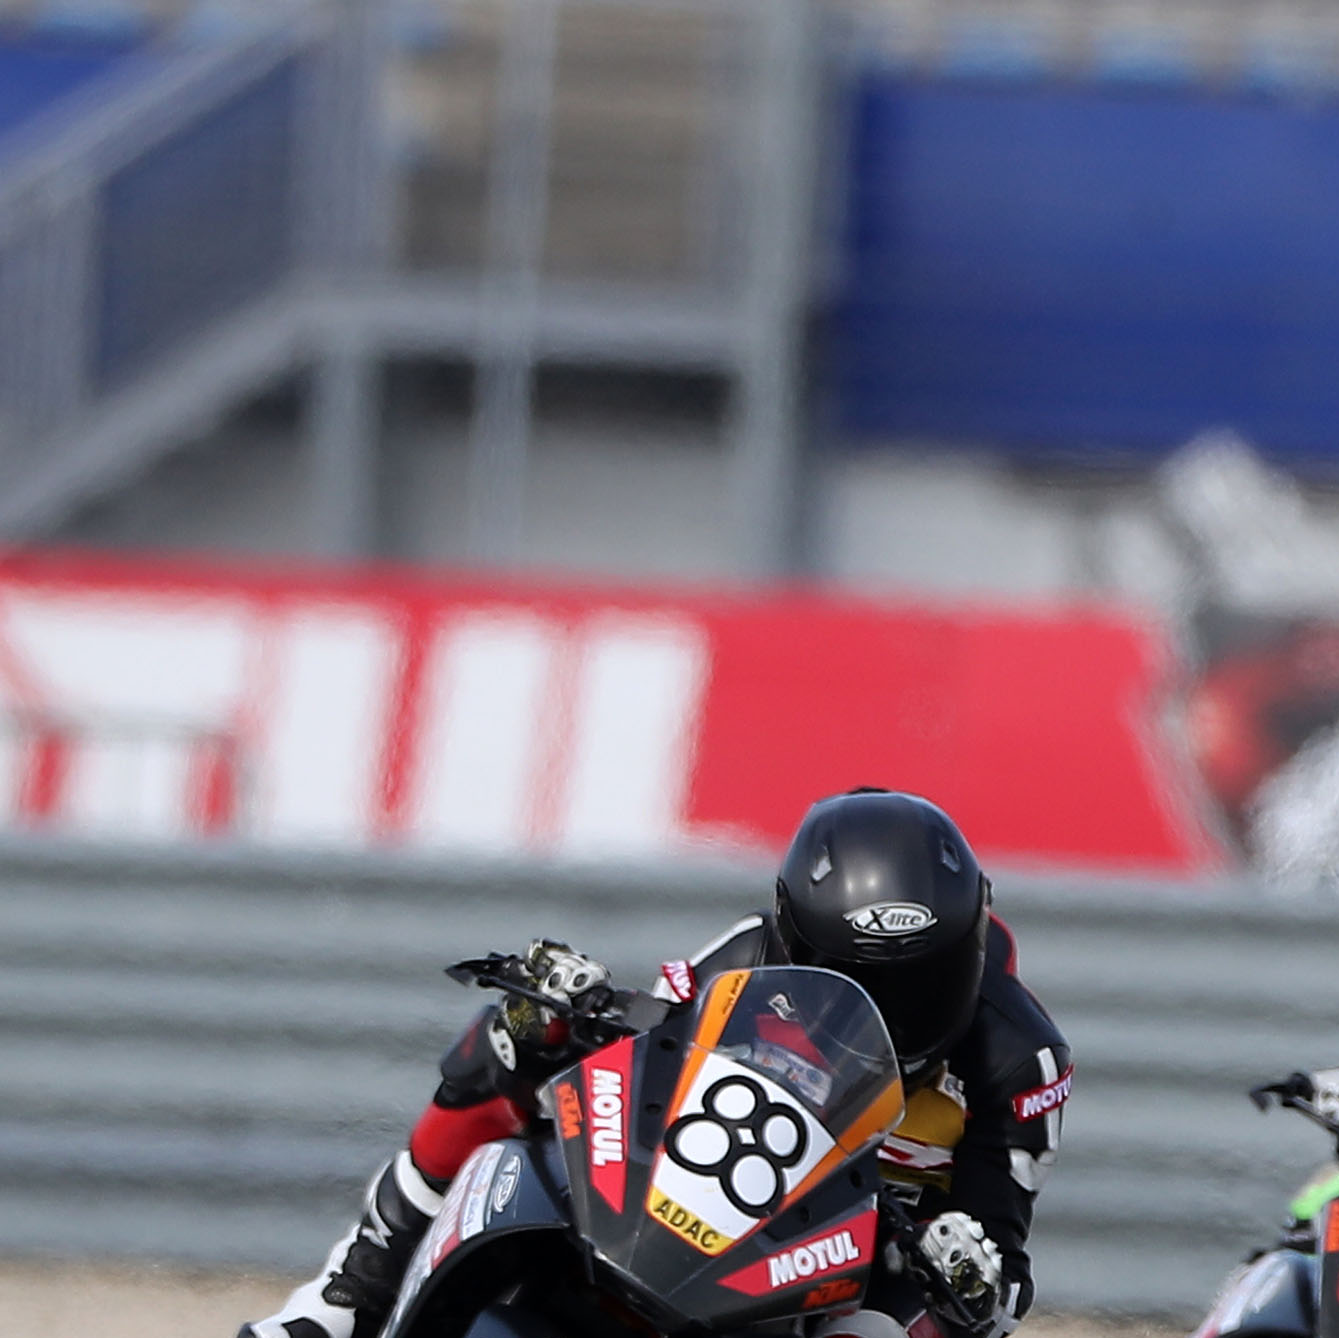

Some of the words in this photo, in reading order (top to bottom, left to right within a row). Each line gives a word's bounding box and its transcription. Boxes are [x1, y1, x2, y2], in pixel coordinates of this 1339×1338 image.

[861, 909, 922, 931] X-lite
[591, 1068, 625, 1167] MOTUL
[664, 1074, 808, 1219] 88
[654, 1199, 718, 1249] ADAC
[768, 1230, 860, 1288] MOTUL
